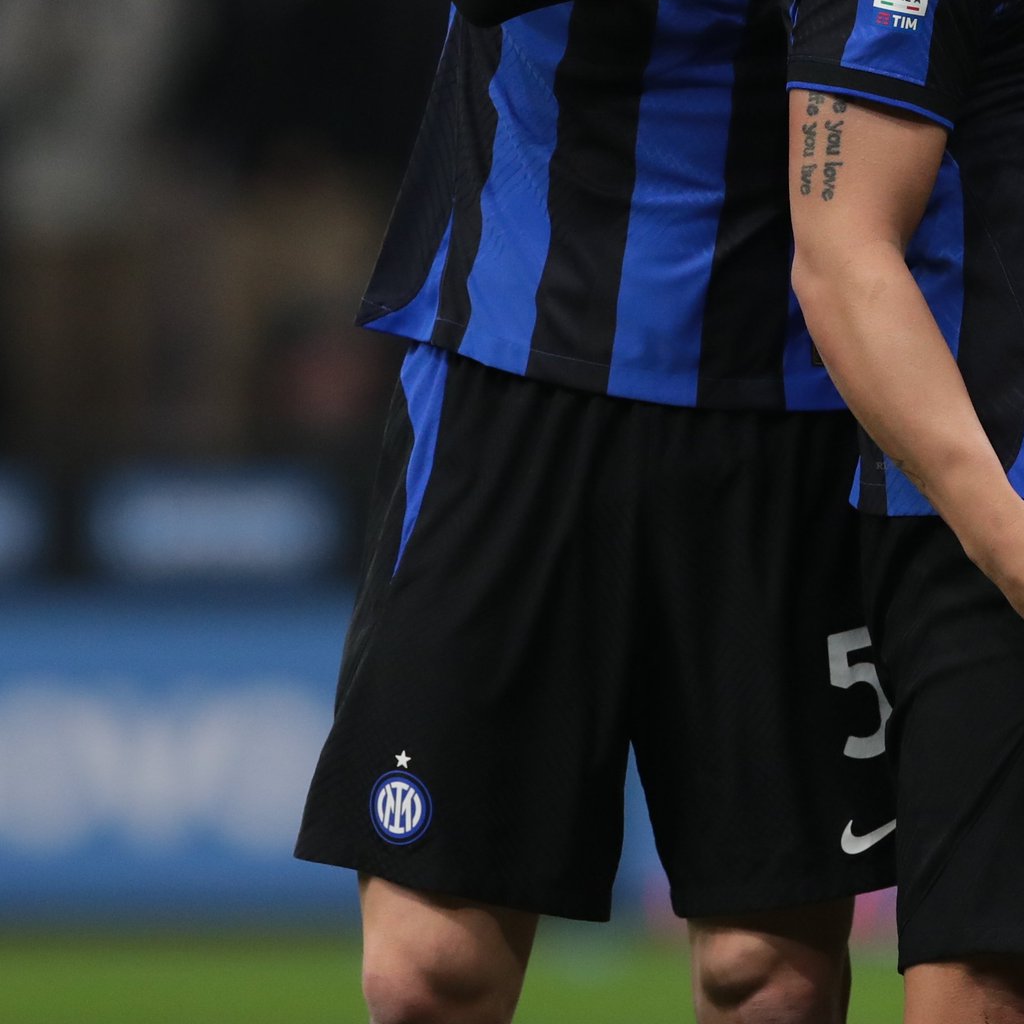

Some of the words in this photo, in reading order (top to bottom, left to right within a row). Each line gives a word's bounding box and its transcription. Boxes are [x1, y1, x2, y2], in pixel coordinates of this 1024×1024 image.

[892, 14, 918, 31] TIM
[802, 120, 818, 158] you
[824, 120, 844, 155] you
[821, 162, 844, 202] love
[827, 626, 893, 759] 5
